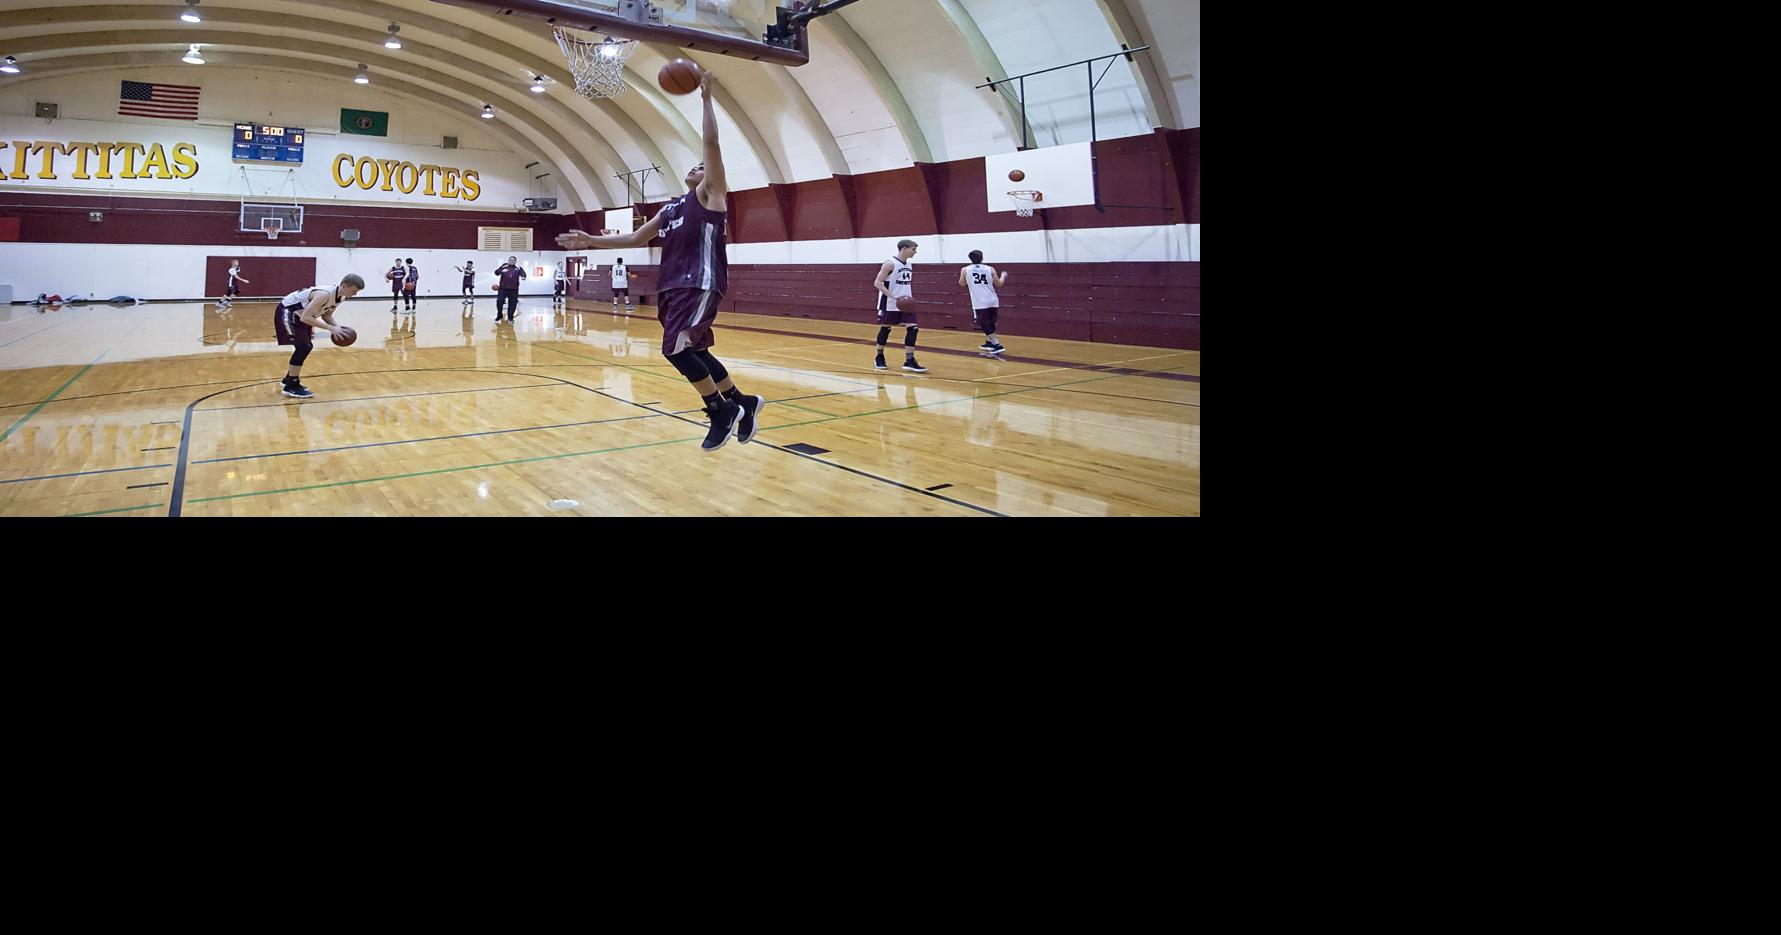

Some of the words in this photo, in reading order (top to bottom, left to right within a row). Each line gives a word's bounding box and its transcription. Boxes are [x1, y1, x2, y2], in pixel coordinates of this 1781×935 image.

[245, 131, 252, 140] 0
[295, 135, 302, 143] 0
[0, 141, 199, 180] ITTITAS
[331, 152, 481, 201] COYOTES
[972, 272, 988, 285] 34
